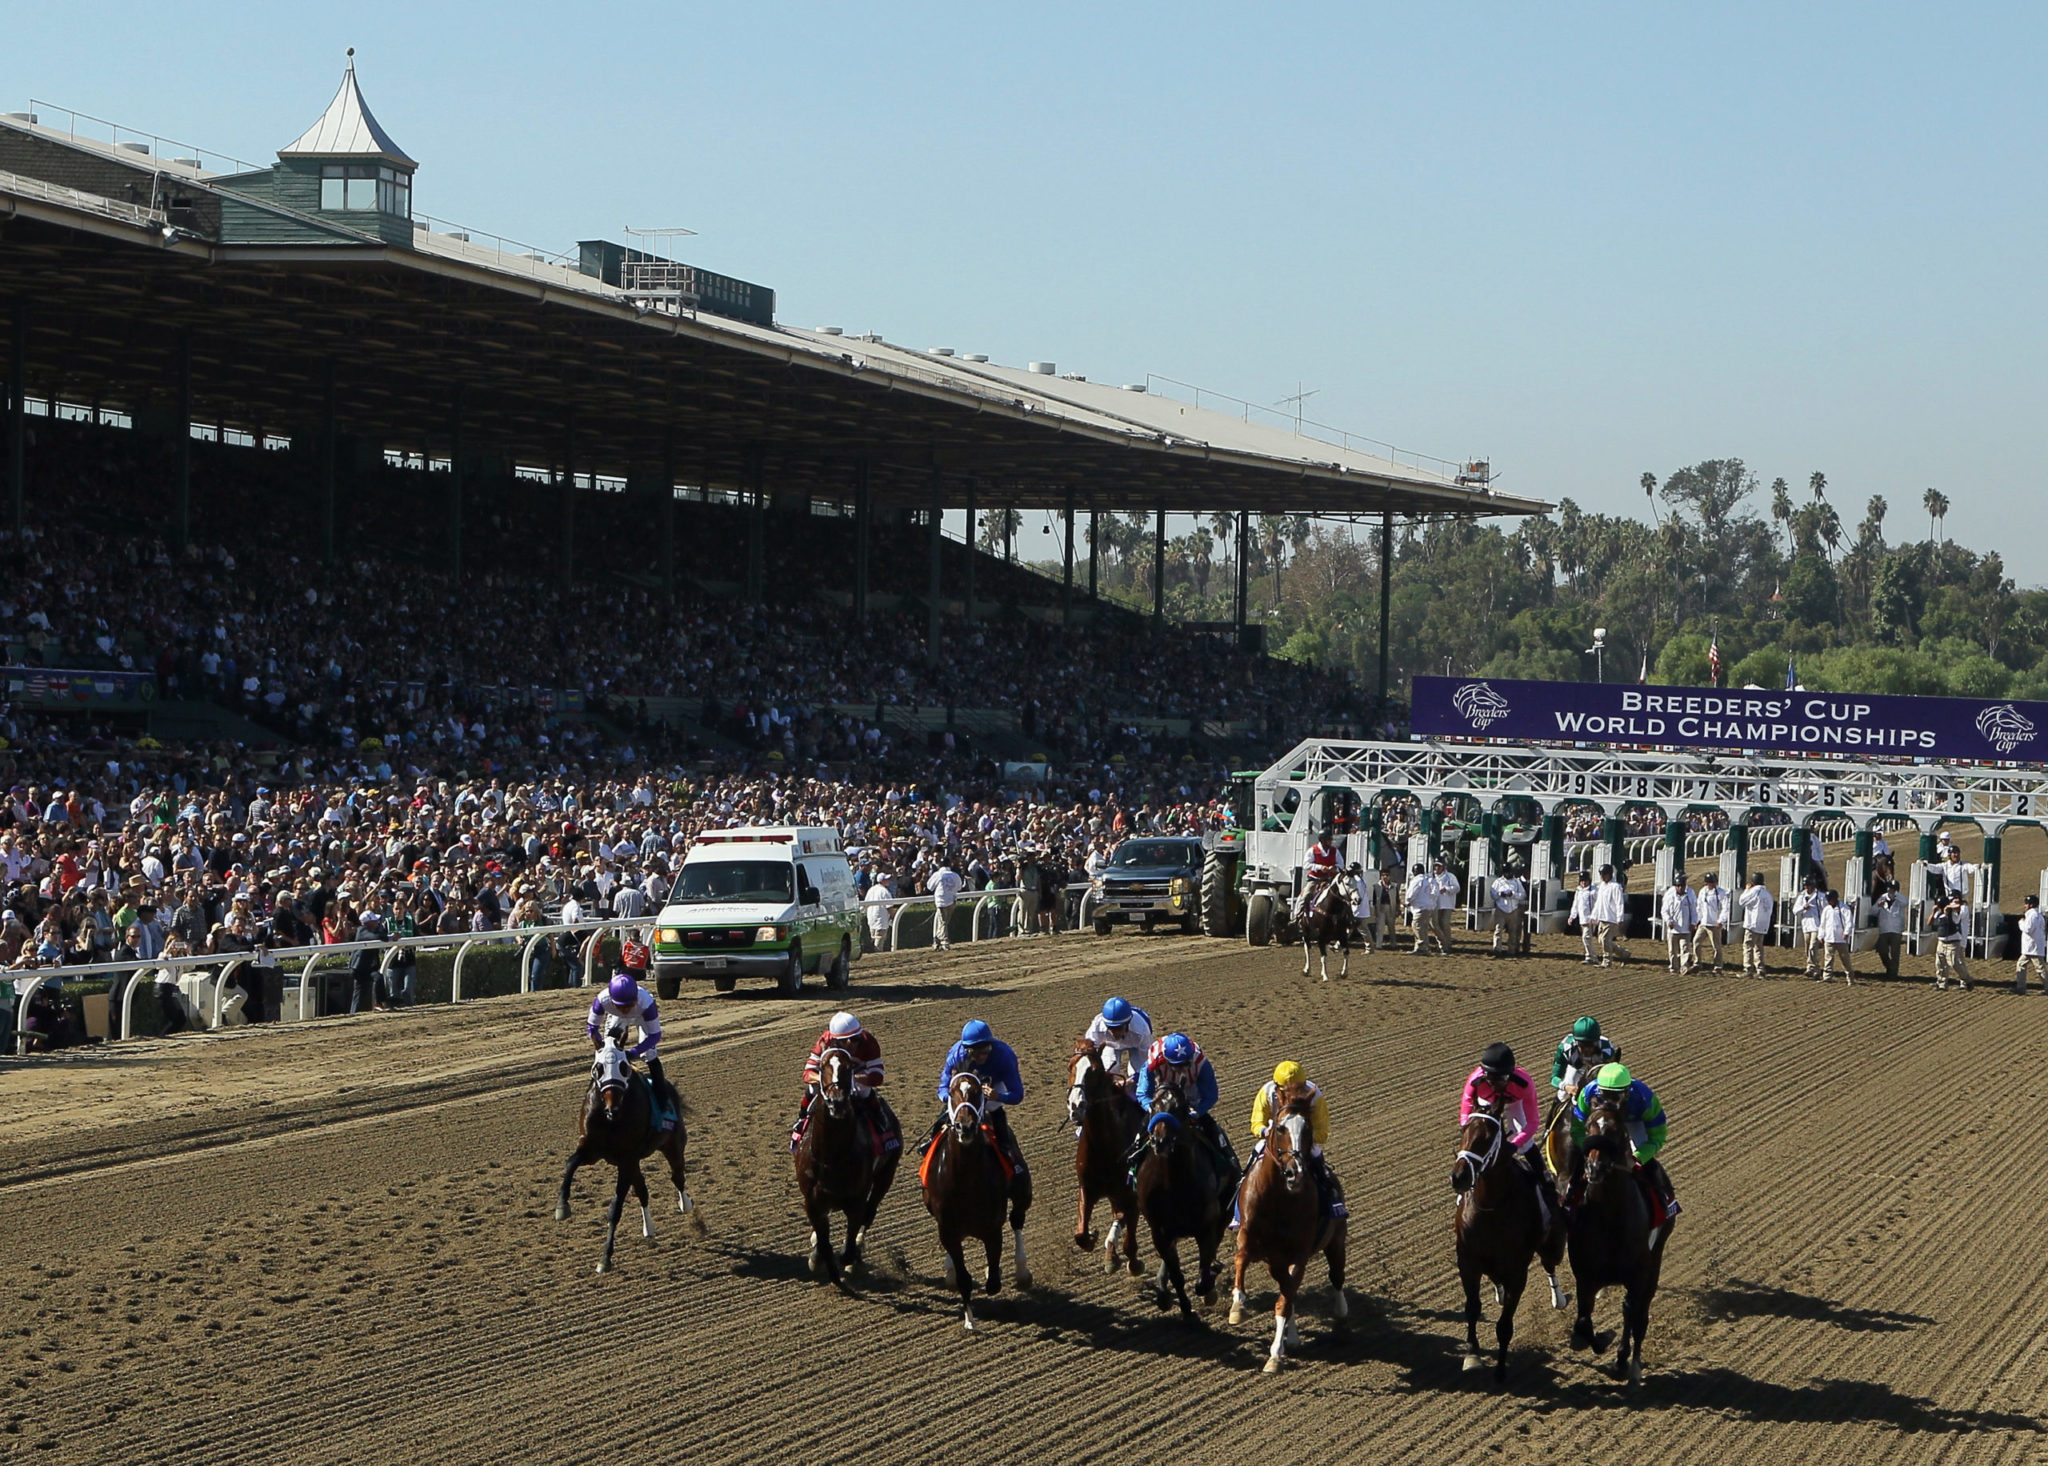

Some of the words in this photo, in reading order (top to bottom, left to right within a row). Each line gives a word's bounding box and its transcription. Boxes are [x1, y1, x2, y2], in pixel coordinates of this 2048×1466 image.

[1622, 691, 1792, 718] BREEDERS'
[1804, 699, 1871, 722] CUP
[1472, 717, 1492, 731] Cup
[1554, 711, 1666, 736] WORLD
[1677, 717, 1936, 748] CHAMPIONSHIPS
[1996, 740, 2017, 754] Cup
[1574, 775, 1586, 795] 9
[1636, 777, 1648, 798] 8
[1698, 780, 1711, 801] 7
[1759, 782, 1771, 804] 6
[1823, 785, 1835, 807] 5
[1887, 789, 1899, 810] 4
[1953, 791, 1965, 813] 3
[2016, 794, 2029, 816] 2
